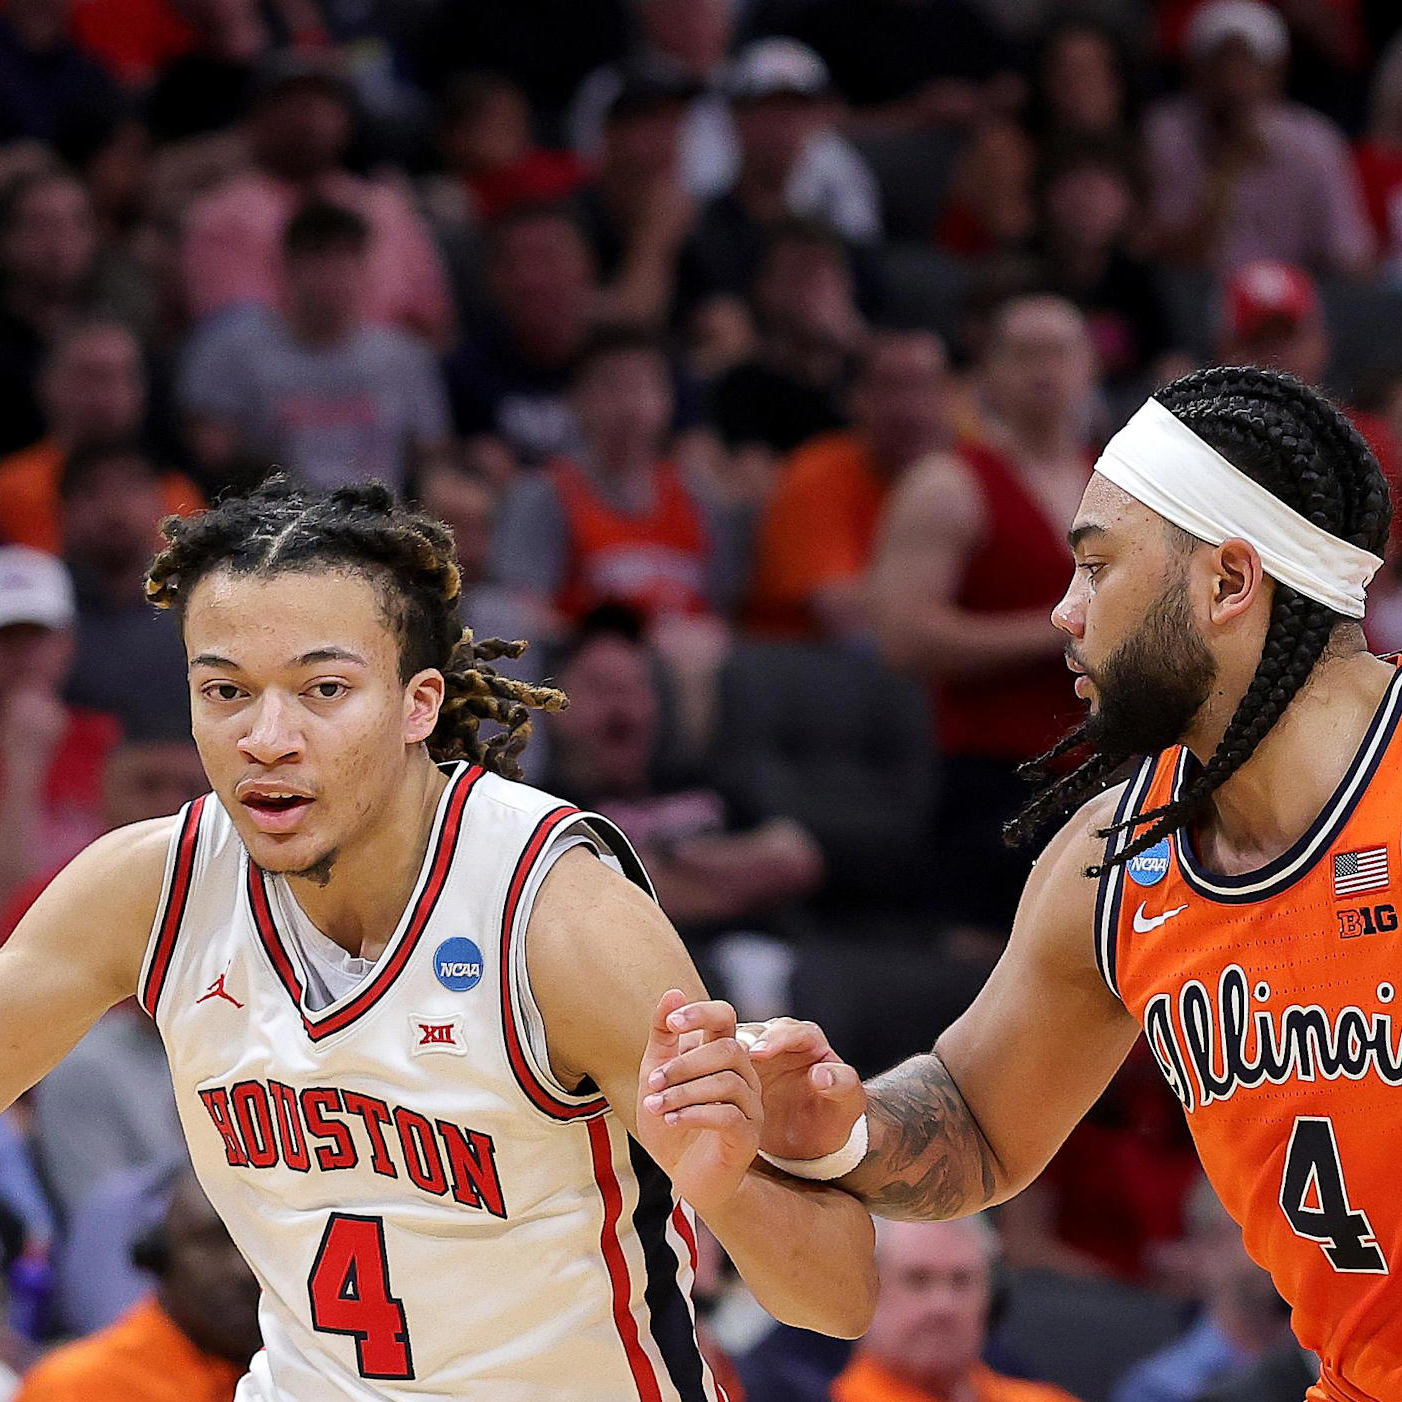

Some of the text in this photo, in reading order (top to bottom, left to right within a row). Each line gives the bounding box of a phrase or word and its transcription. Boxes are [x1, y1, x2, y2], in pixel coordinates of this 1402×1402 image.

[1130, 855, 1168, 874] NCAA
[440, 961, 481, 978] NCAA
[418, 1023, 457, 1045] XII
[198, 1079, 508, 1220] HOUSTON
[1278, 1115, 1390, 1276] 4
[306, 1211, 416, 1380] 4
